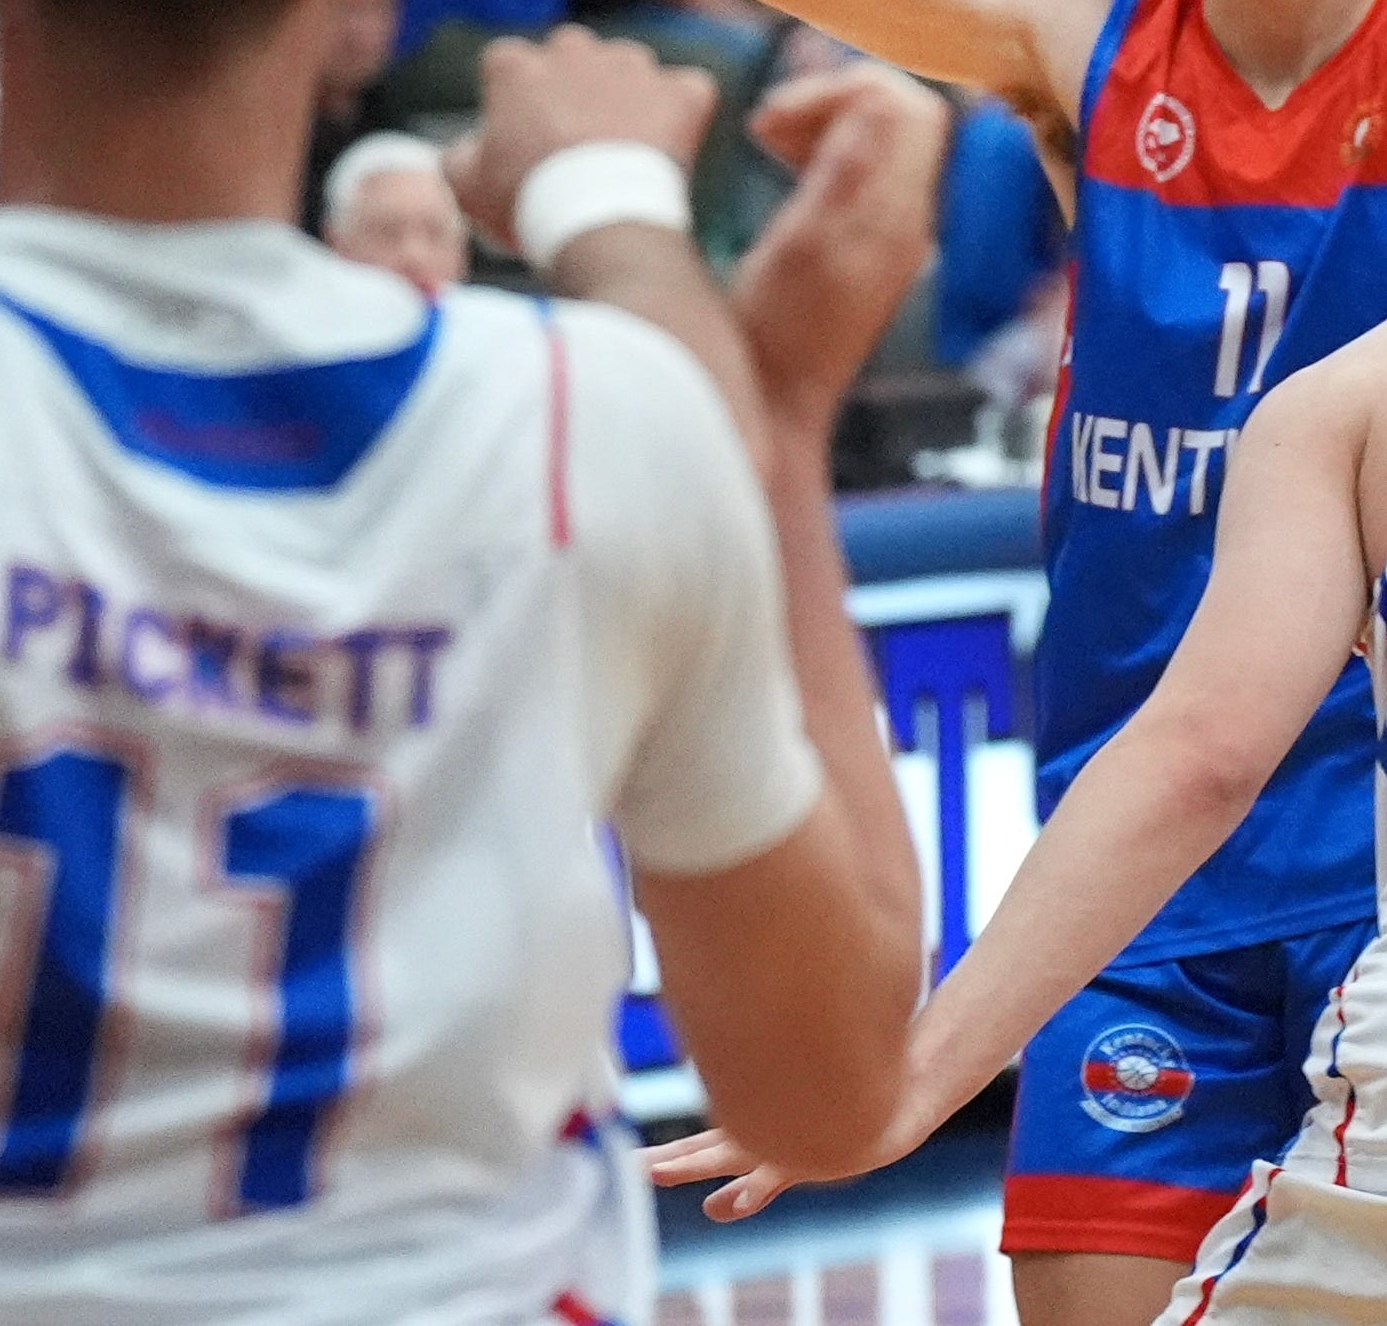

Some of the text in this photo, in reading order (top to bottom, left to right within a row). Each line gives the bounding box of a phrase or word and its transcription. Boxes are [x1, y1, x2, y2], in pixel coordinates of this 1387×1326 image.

[1214, 260, 1291, 399] 11
[1070, 411, 1242, 516] KENT
[0, 564, 455, 733] PICKETT
